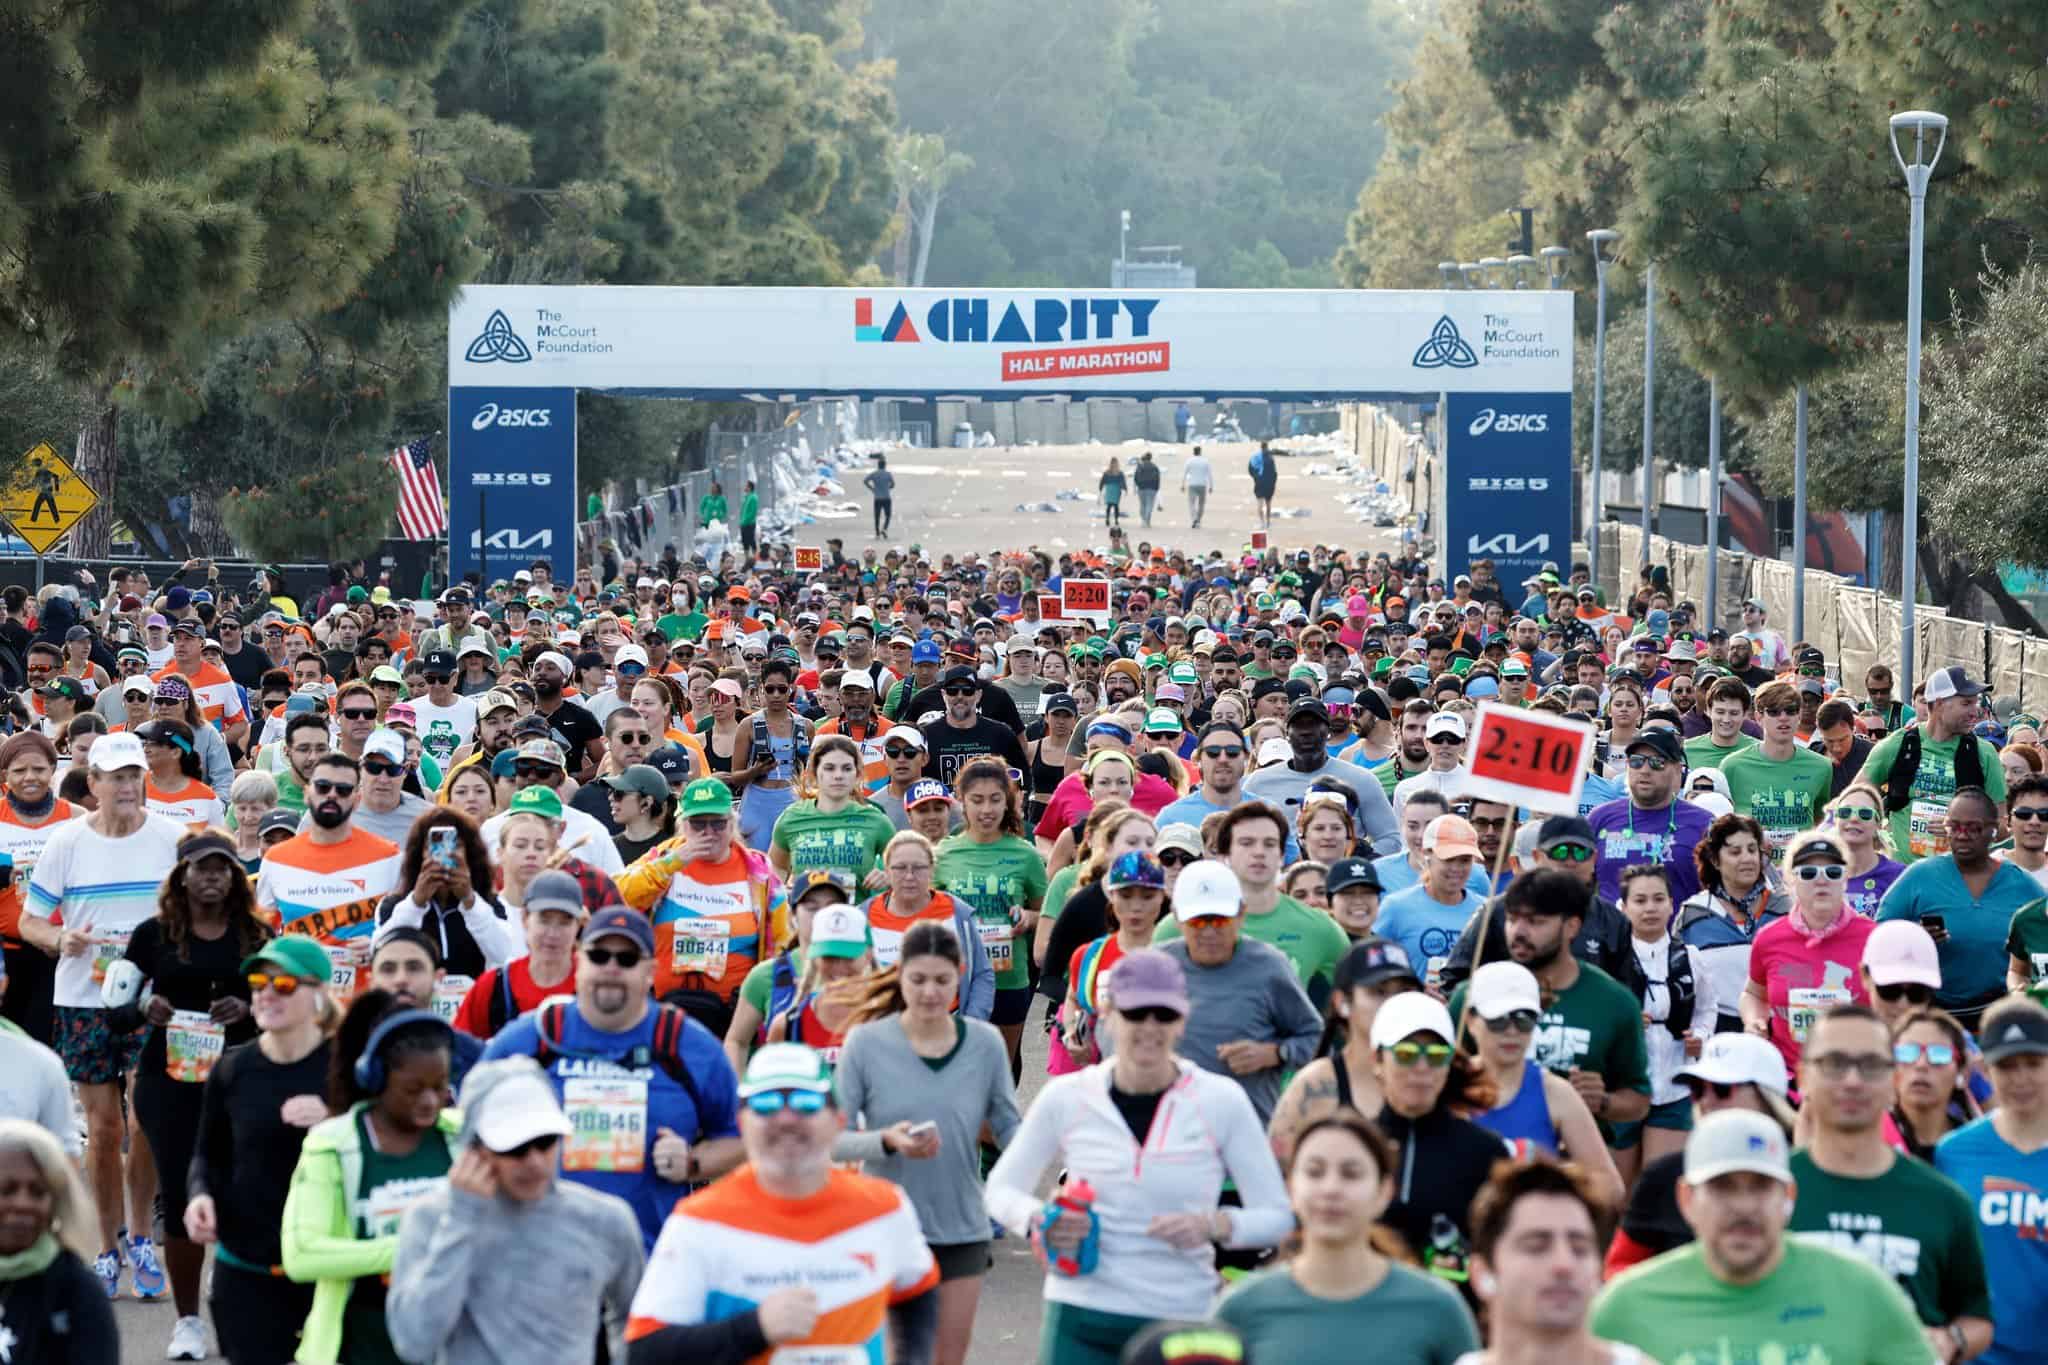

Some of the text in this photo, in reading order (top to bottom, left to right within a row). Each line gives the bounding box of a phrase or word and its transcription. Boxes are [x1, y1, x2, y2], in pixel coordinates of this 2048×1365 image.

[536, 309, 562, 321] The
[855, 298, 1160, 342] LA CHARITY
[1484, 314, 1509, 327] The
[537, 325, 597, 337] McCourt
[1484, 330, 1543, 343] McCourt
[537, 340, 613, 353] Foundation
[1484, 345, 1560, 358] Foundation
[1009, 350, 1162, 374] HALF MARATHON
[472, 473, 552, 486] BIG 5
[1468, 478, 1549, 491] BIG 5
[471, 528, 552, 549] KIA
[1468, 533, 1549, 554] KIA
[1068, 587, 1104, 602] 2:20
[1483, 726, 1574, 775] 2:10
